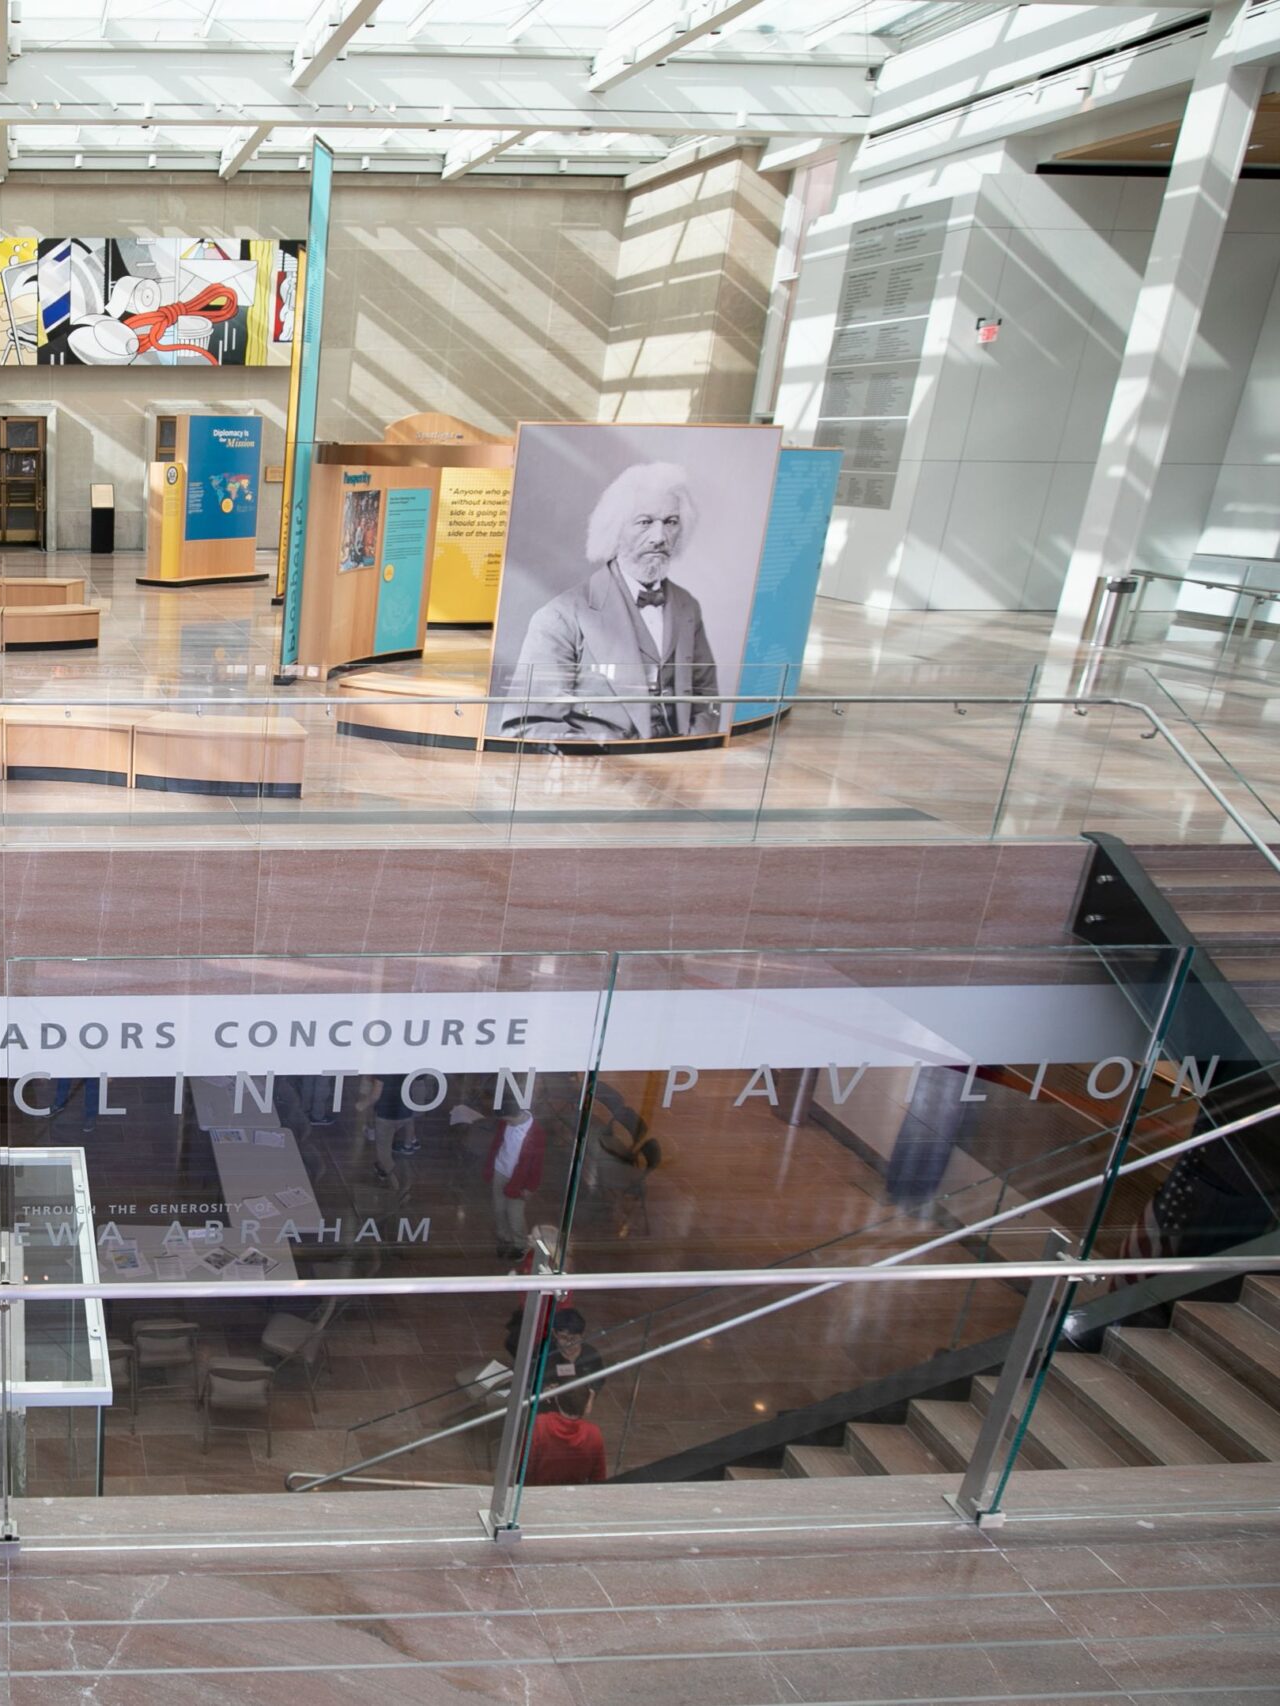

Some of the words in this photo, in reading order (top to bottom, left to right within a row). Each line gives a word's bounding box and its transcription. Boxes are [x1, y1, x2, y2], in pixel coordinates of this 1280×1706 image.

[213, 429, 243, 438] Diplomacy
[476, 510, 497, 518] going
[477, 520, 498, 528] study
[214, 1018, 529, 1048] CONCOURSE
[13, 1067, 536, 1117] CLINTON
[662, 1055, 1220, 1108] PAVILION
[22, 1204, 97, 1216] THROUGH
[109, 1204, 137, 1215] THE
[149, 1203, 242, 1214] GENEROSITY
[255, 1202, 274, 1212] OF
[14, 1221, 125, 1247] EWA
[162, 1217, 431, 1246] ABRAHAM
